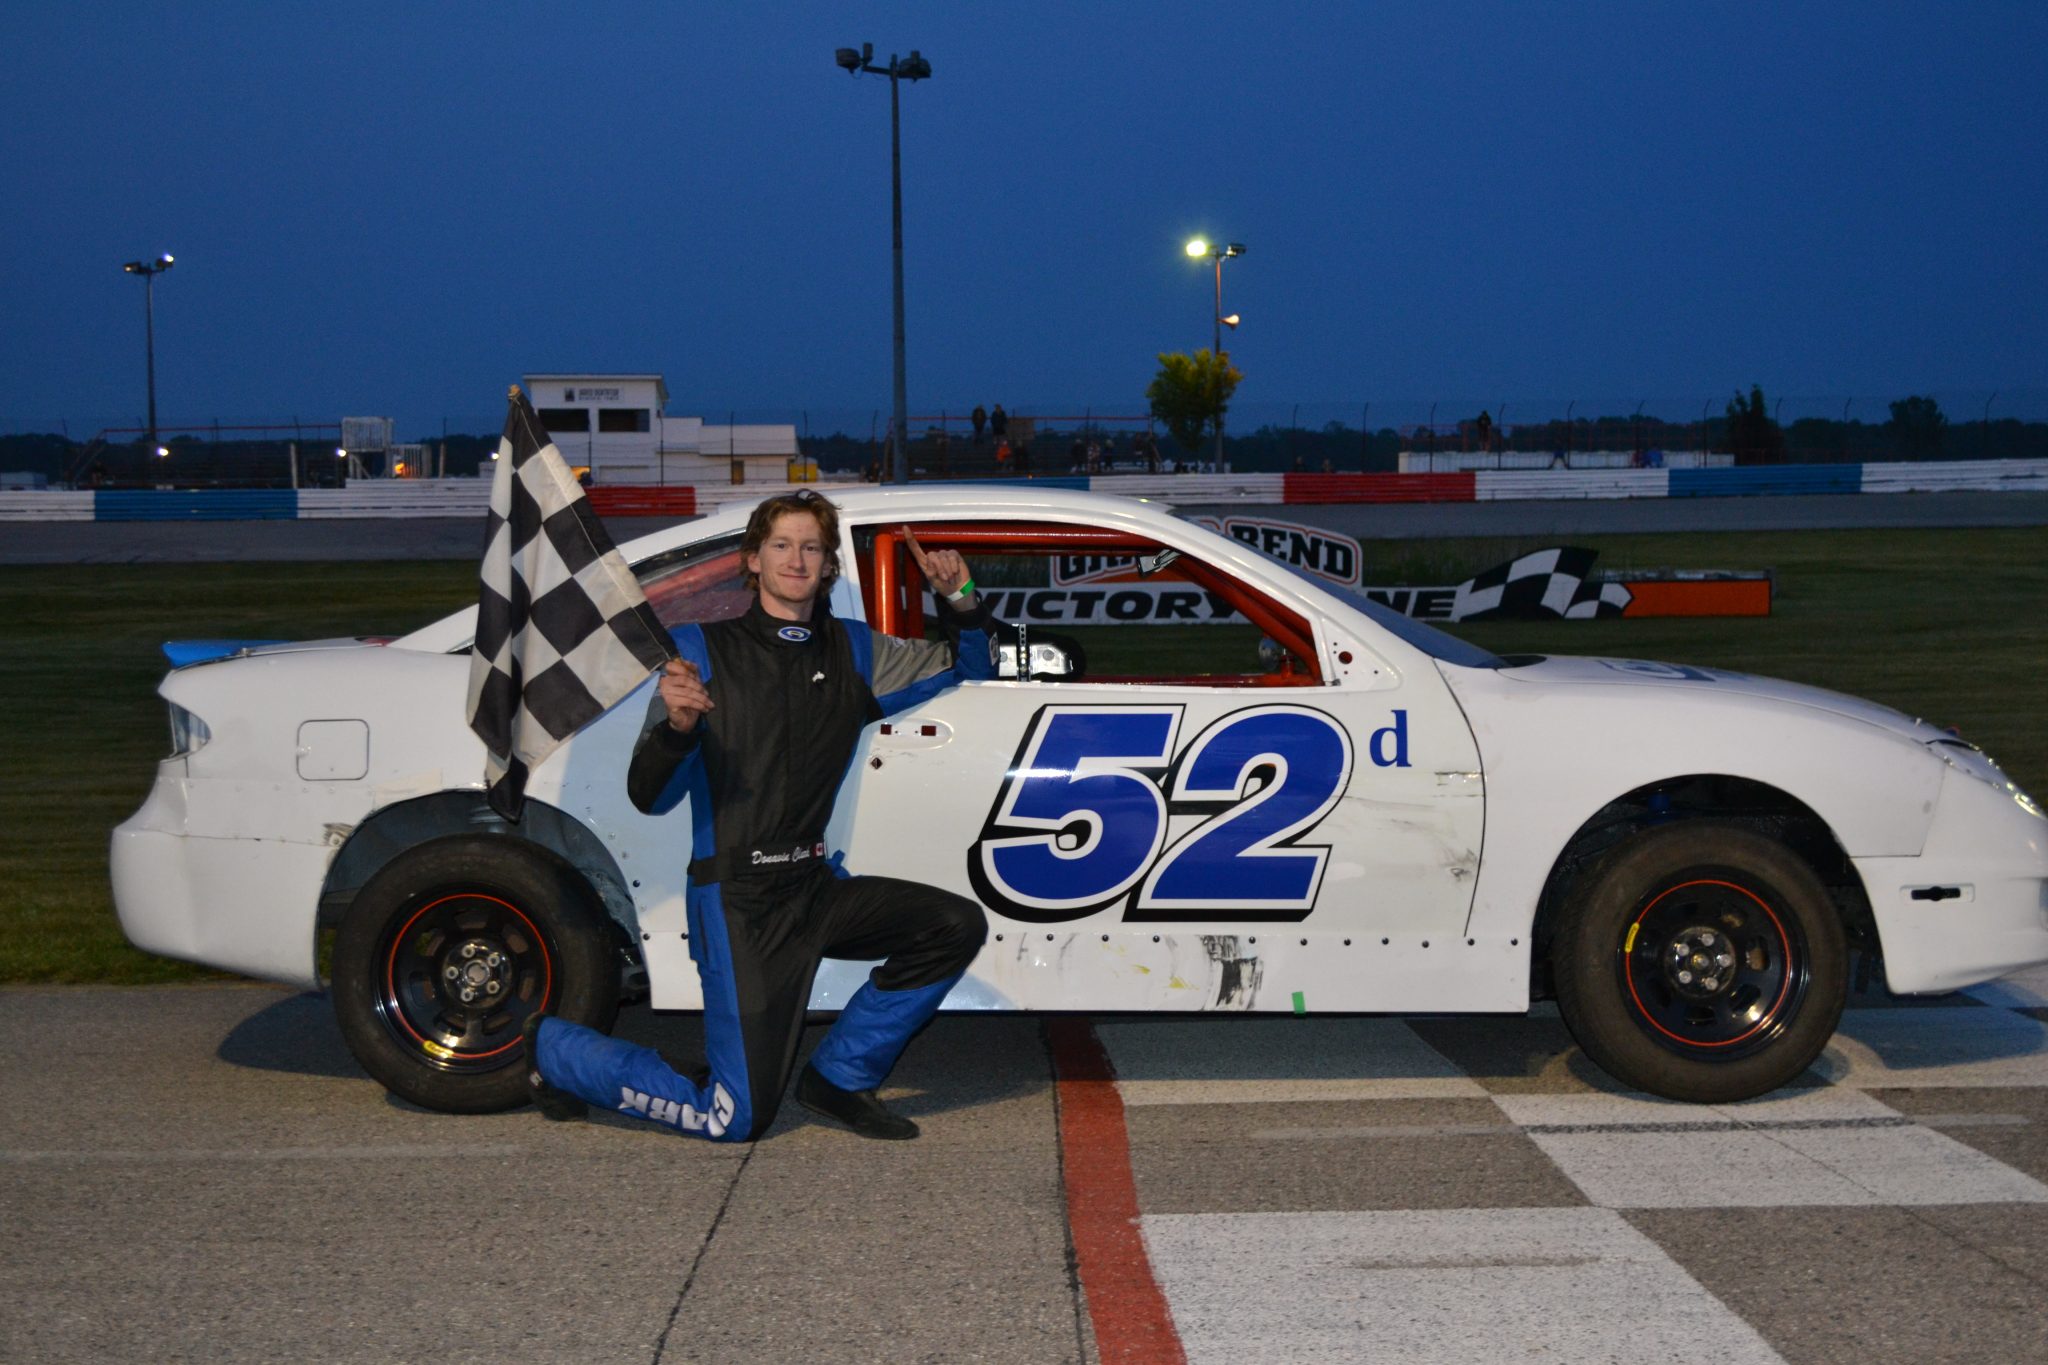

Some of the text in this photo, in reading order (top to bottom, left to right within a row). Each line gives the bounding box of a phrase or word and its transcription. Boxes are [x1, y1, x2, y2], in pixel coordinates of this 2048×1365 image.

[1230, 524, 1353, 579] BEND
[1365, 590, 1457, 618] NE
[967, 703, 1412, 923] 52 d
